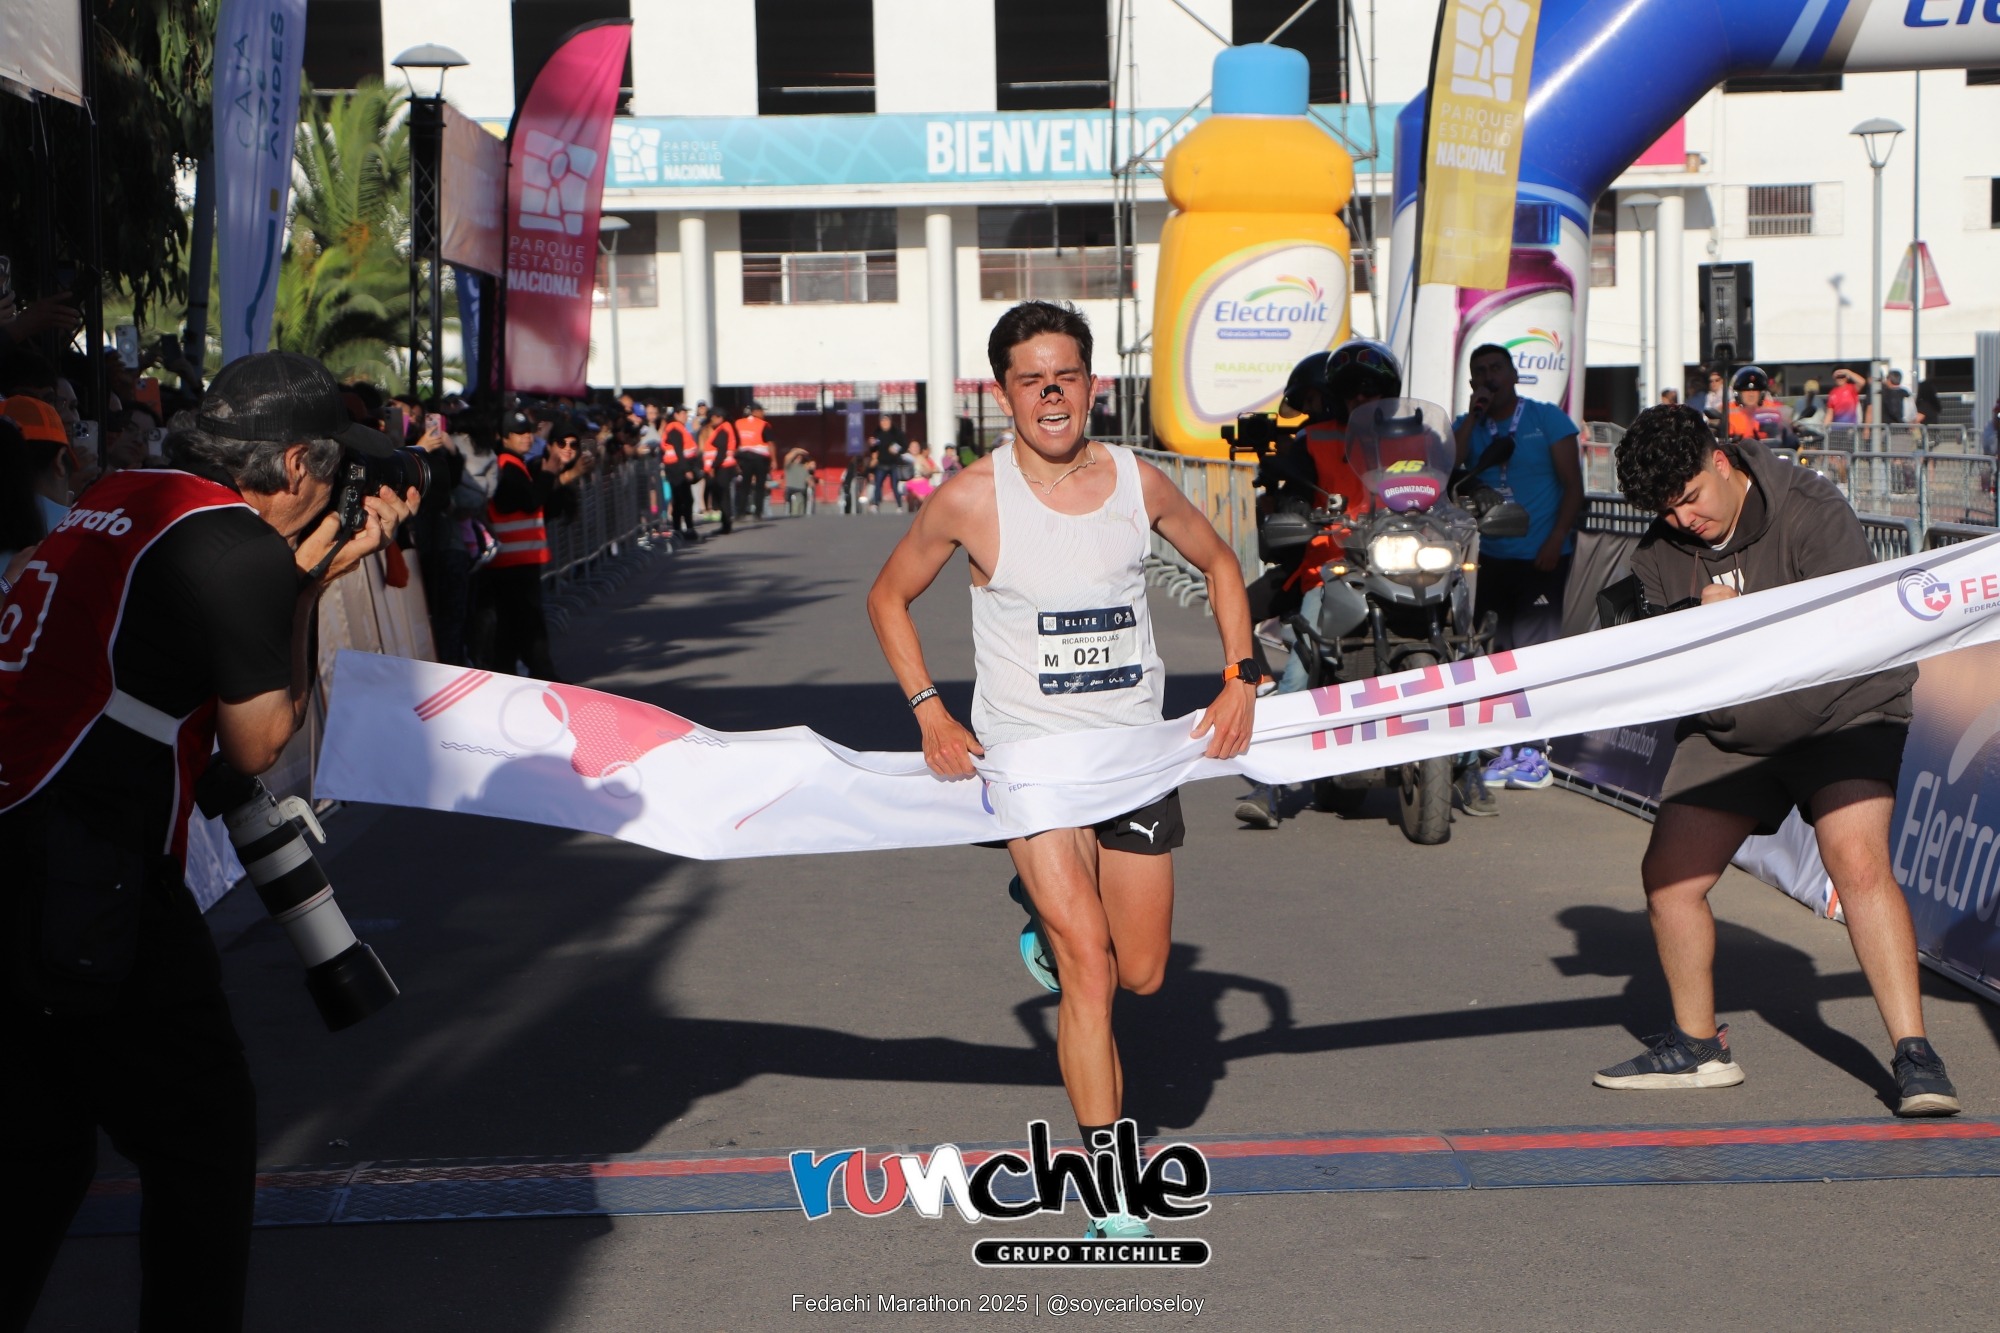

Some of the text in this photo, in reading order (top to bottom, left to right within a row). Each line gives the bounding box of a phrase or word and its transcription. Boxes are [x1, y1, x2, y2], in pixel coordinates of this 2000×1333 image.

[233, 34, 254, 149] CAJA
[270, 11, 284, 160] ANDES
[1441, 102, 1514, 131] PARQUE
[663, 141, 719, 151] PARQUE
[1438, 122, 1512, 147] ESTADIO
[663, 151, 722, 162] ESTADIO
[1436, 141, 1506, 176] NACIONAL
[663, 163, 725, 181] NACIONAL
[510, 235, 585, 259] PARQUE
[508, 252, 584, 274] ESTADIO
[507, 268, 581, 298] NACIONAL
[1214, 300, 1328, 323] Electrolit
[1385, 460, 1426, 474] 46
[1384, 485, 1436, 499] ORGANIZACIÓN
[56, 507, 132, 536] grafo
[1065, 617, 1097, 627] ELITE
[1062, 633, 1120, 646] RICARDO ROJAS
[1044, 646, 1111, 668] M 021
[1892, 770, 2000, 927] Electro
